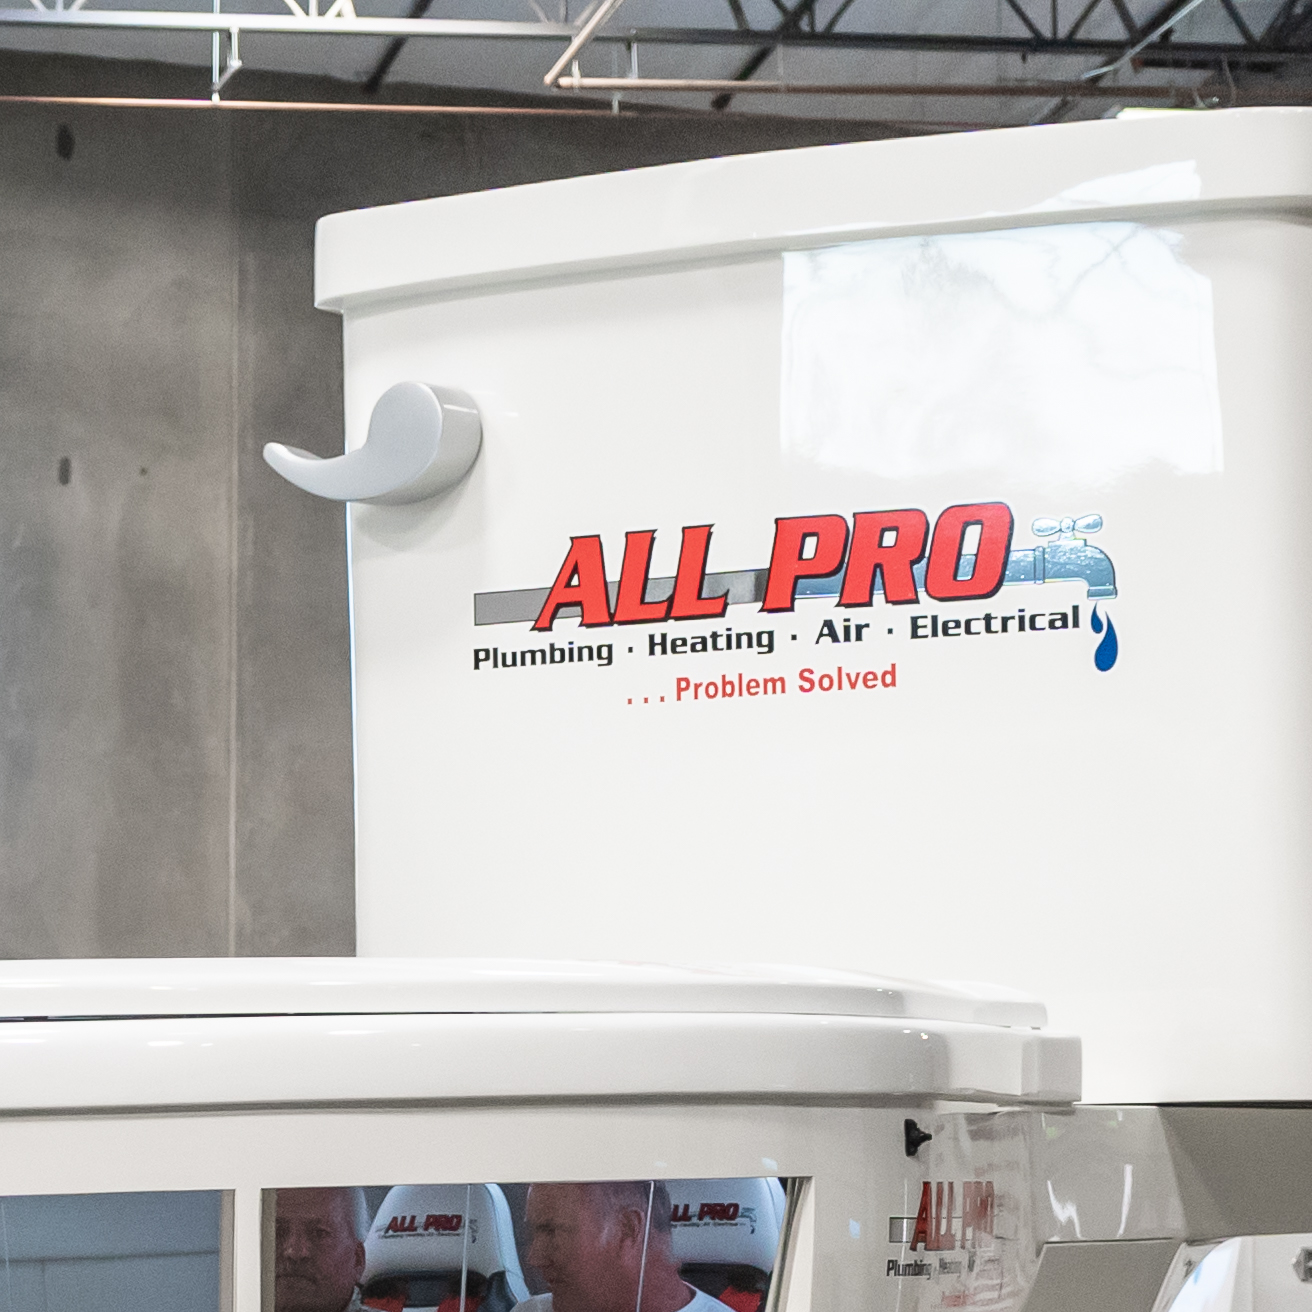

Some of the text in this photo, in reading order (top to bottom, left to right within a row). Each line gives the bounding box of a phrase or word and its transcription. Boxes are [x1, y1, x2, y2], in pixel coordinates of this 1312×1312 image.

[530, 502, 1015, 632] ALL PRO
[472, 605, 1081, 670] Plumbing Heating Air Electrical
[798, 663, 899, 696] Solved
[387, 1214, 463, 1233] ALL PRO
[697, 1202, 740, 1220] PRO
[909, 1181, 956, 1251] ALL
[886, 1259, 932, 1280] Plumbing
